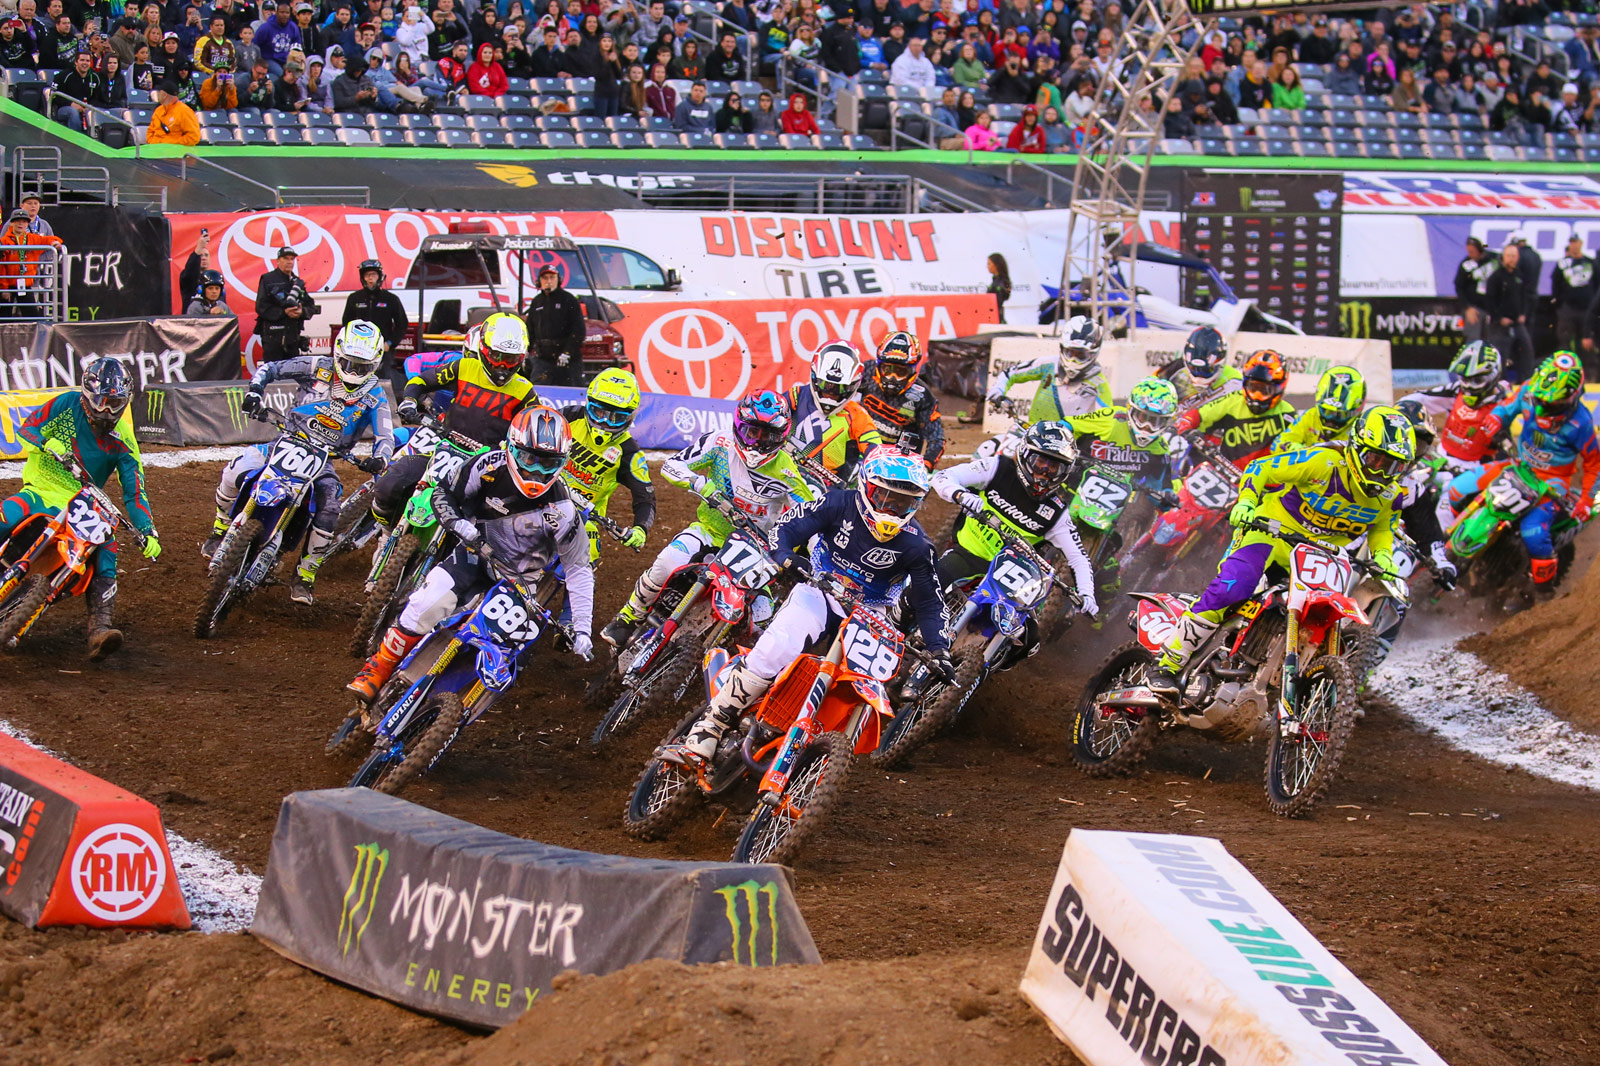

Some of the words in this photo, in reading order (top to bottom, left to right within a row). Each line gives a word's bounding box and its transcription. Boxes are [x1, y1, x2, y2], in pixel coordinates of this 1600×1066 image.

[701, 216, 939, 262] DISCOUNT
[775, 268, 882, 298] TIRE
[756, 305, 956, 364] TOYOTA
[1376, 310, 1464, 338] MONSTE
[306, 417, 339, 441] CONCORD
[1224, 419, 1282, 448] ONEAL
[269, 440, 323, 479] 760
[568, 437, 616, 476] HIFT
[987, 489, 1044, 531] FASTHOUSE
[1082, 475, 1128, 510] 62
[1488, 478, 1532, 514] 201
[67, 499, 112, 547] 326
[1299, 501, 1367, 536] GEICO
[832, 551, 875, 579] GoPro
[1300, 551, 1349, 594] 50
[481, 593, 541, 641] 682
[1139, 611, 1175, 645] 50
[842, 622, 899, 682] 128
[386, 686, 421, 729] DUNLOP
[90, 852, 147, 893] RM
[389, 872, 584, 967] MONSTER
[405, 962, 540, 1011] ENERGY
